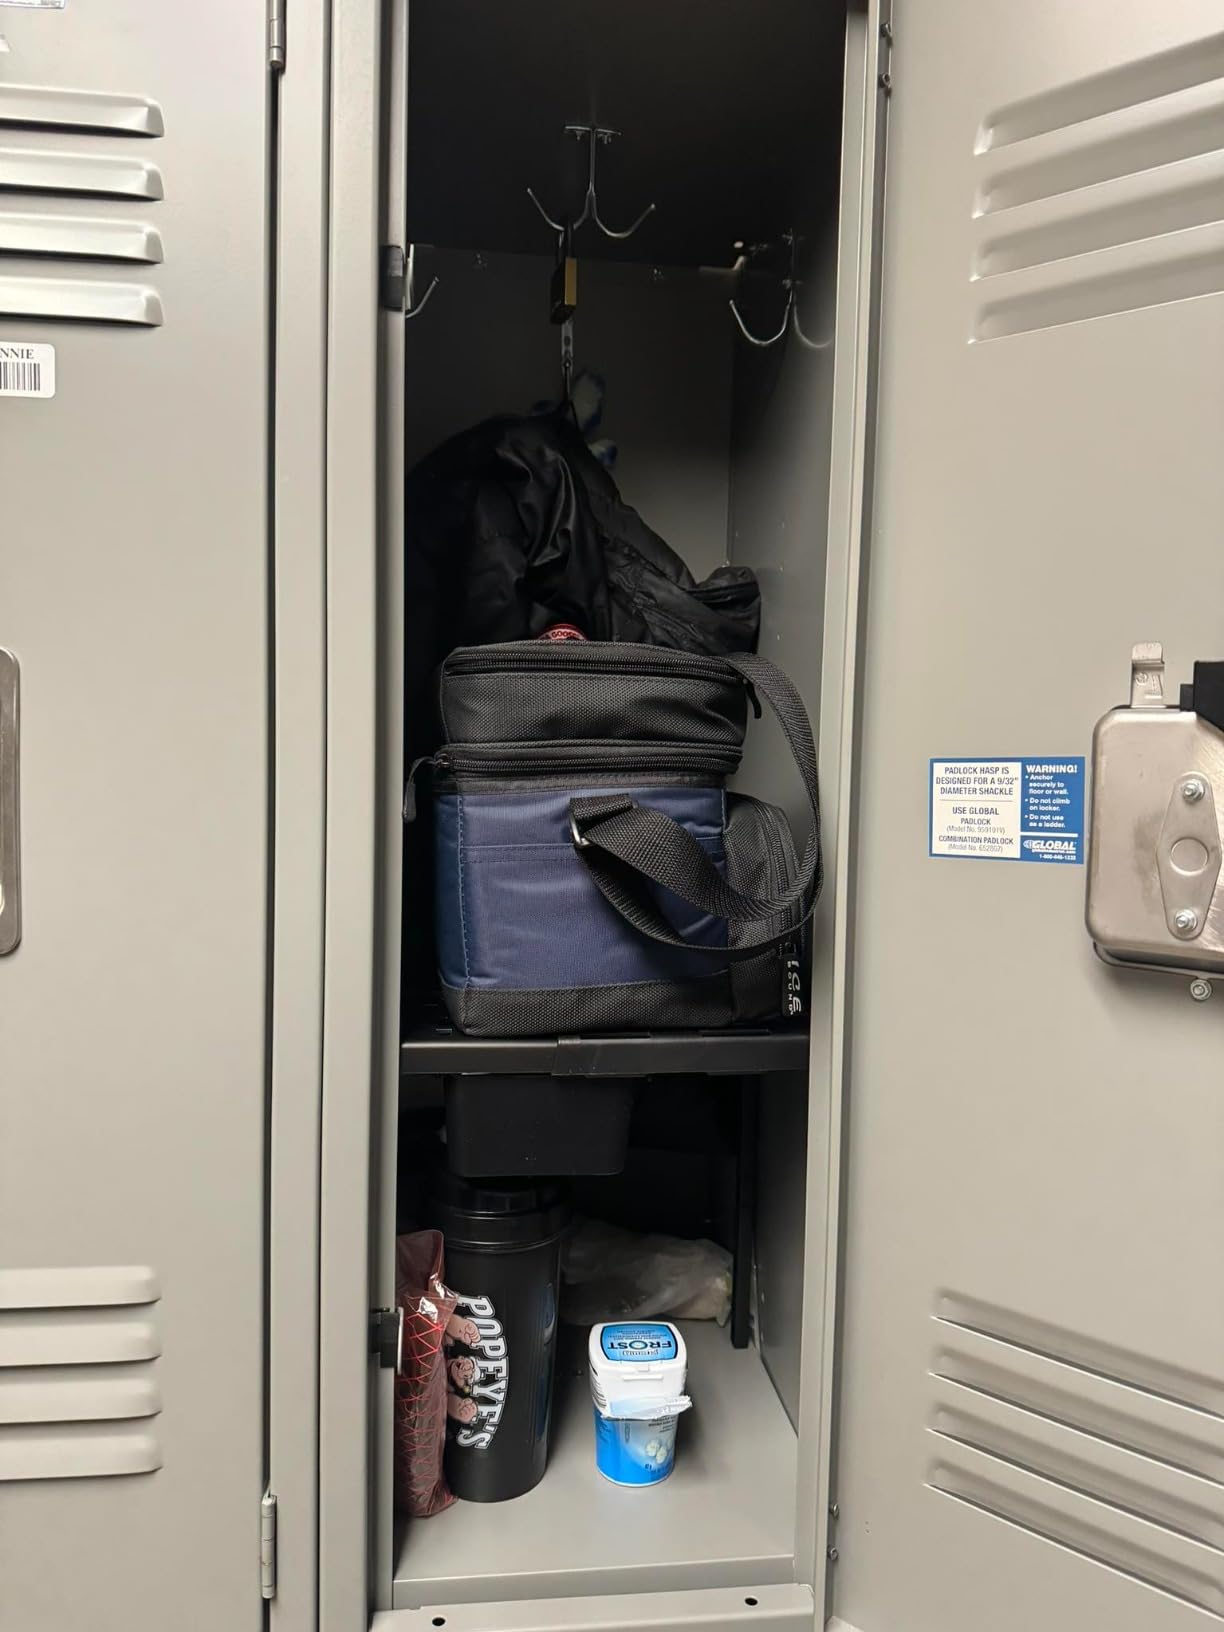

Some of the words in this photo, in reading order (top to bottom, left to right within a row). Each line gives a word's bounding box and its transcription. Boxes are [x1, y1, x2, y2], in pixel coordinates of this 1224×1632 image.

[945, 766, 977, 775] PADLOCK
[1026, 764, 1077, 773] WARNING!
[939, 835, 982, 844] COMBINATION
[1032, 840, 1076, 850] GLOBAL
[608, 1340, 672, 1350] FROST
[456, 1296, 510, 1449] POPEYE'S
